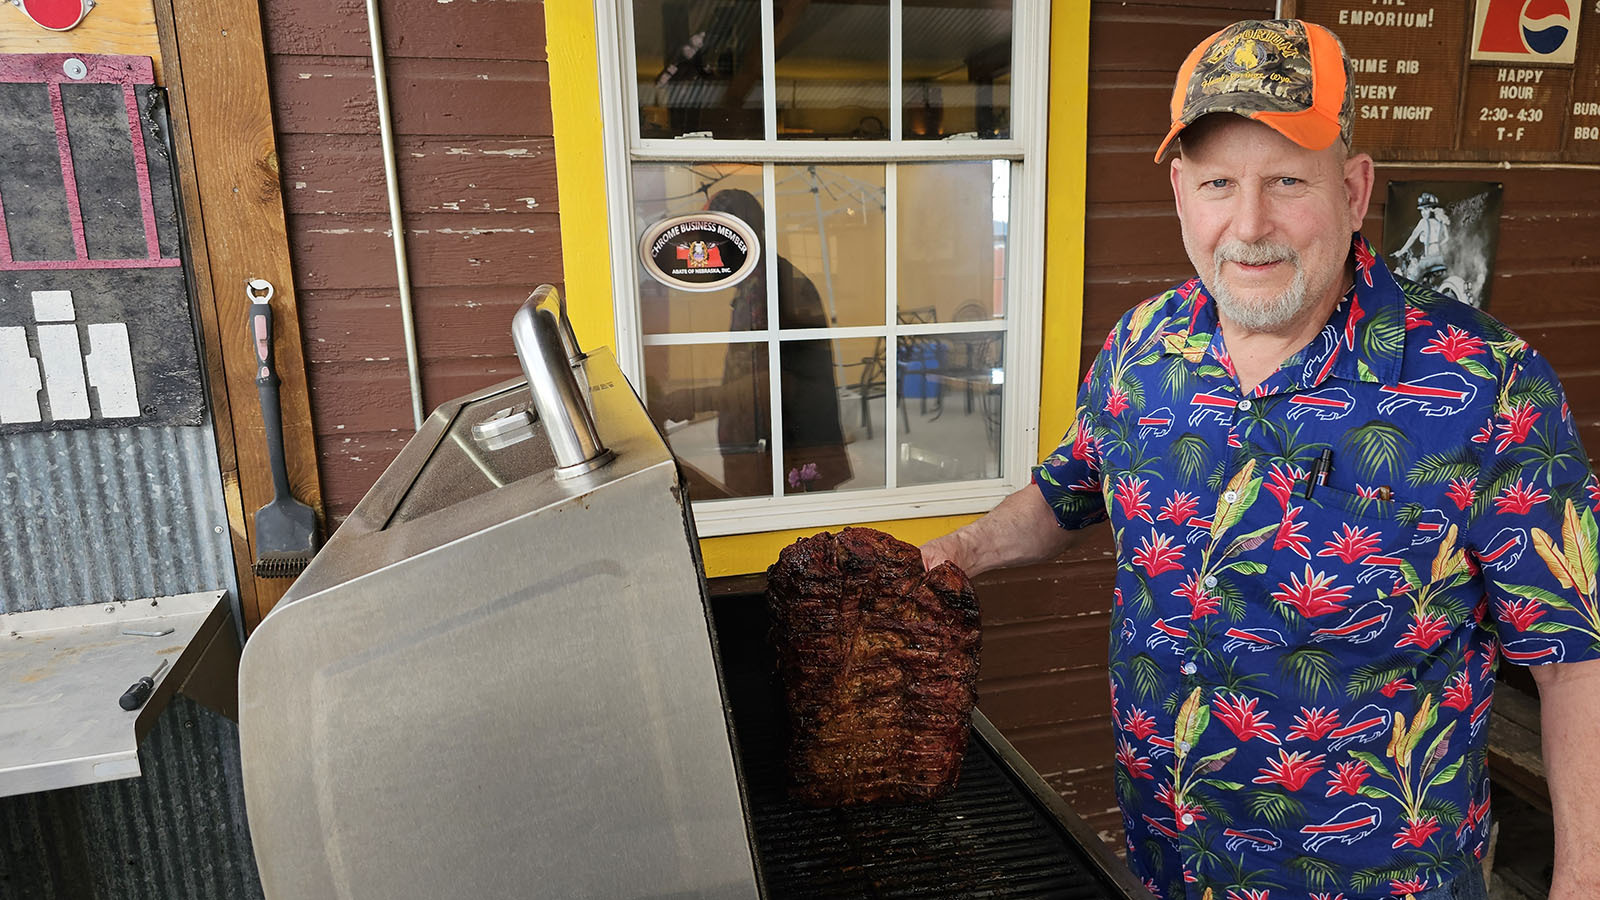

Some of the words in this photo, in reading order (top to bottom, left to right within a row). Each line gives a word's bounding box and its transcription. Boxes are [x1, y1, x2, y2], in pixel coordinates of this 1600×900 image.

[1339, 8, 1434, 28] EMPORIUM!
[1350, 59, 1388, 73] RIME
[1396, 60, 1420, 74] RIB
[1497, 68, 1544, 83] HAPPY
[1499, 85, 1534, 100] HOUR
[1360, 105, 1389, 120] SAT
[1392, 105, 1434, 120] NIGHT
[1574, 126, 1600, 140] BBQ
[651, 226, 680, 258] CHROME
[680, 221, 717, 233] BUSINESS
[717, 225, 748, 255] MEMBER
